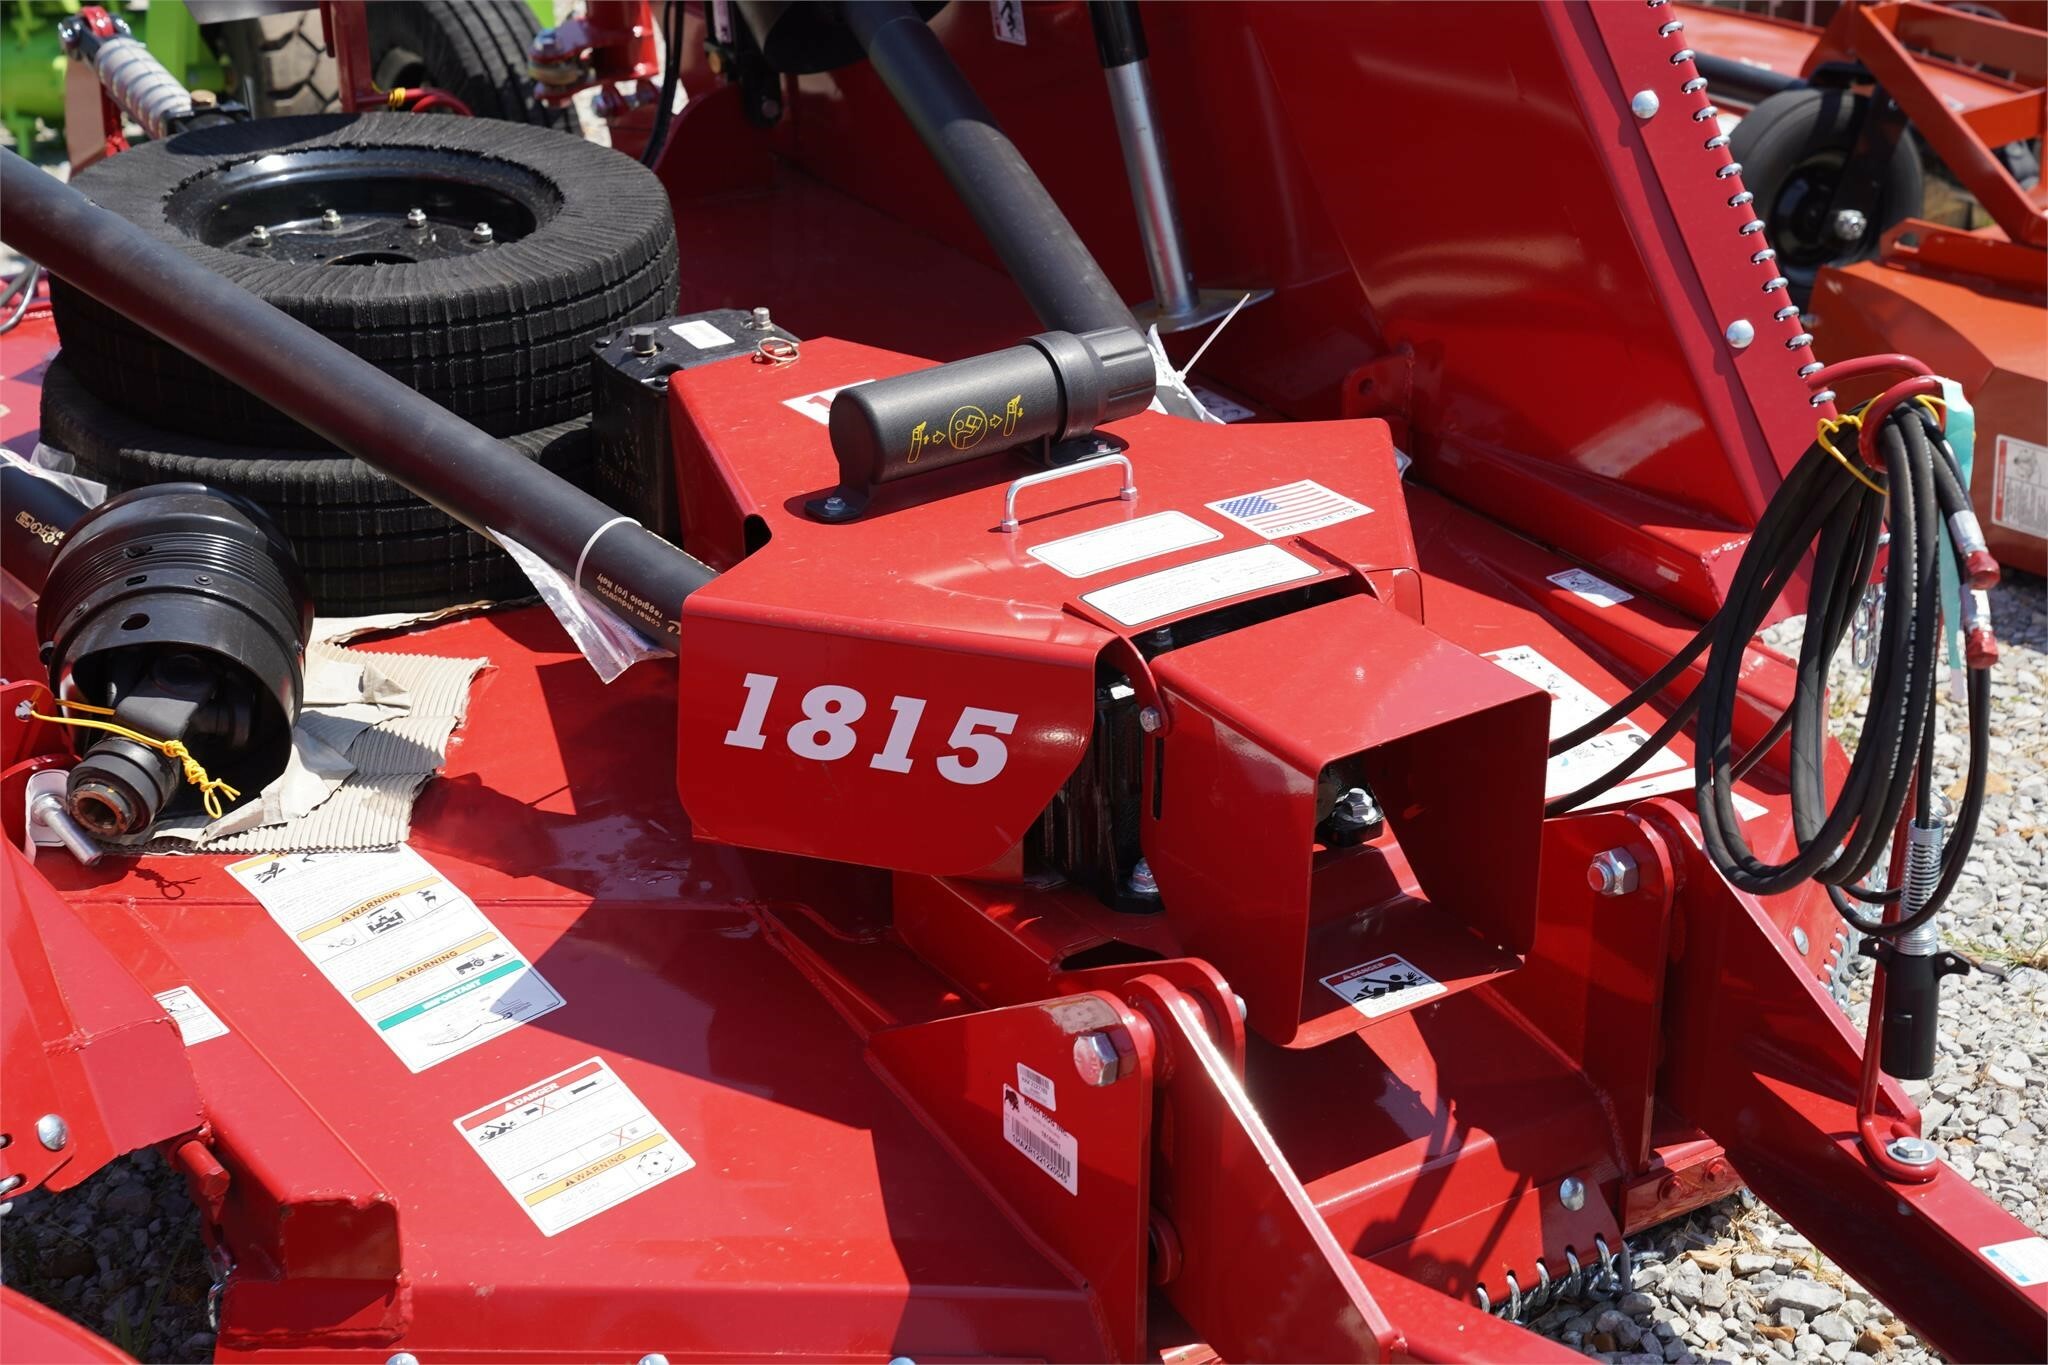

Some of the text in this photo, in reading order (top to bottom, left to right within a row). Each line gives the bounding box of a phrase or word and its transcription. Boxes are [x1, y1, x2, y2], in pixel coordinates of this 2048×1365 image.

[1265, 507, 1361, 535] MADE IN THE USA
[724, 673, 1019, 785] 1815
[350, 891, 401, 918] WARNING
[406, 950, 459, 977] WARNING
[1350, 962, 1386, 977] DANGER
[422, 979, 482, 1010] IMPORTANT
[514, 1082, 559, 1106] DANGER
[575, 1153, 627, 1182] WARNING
